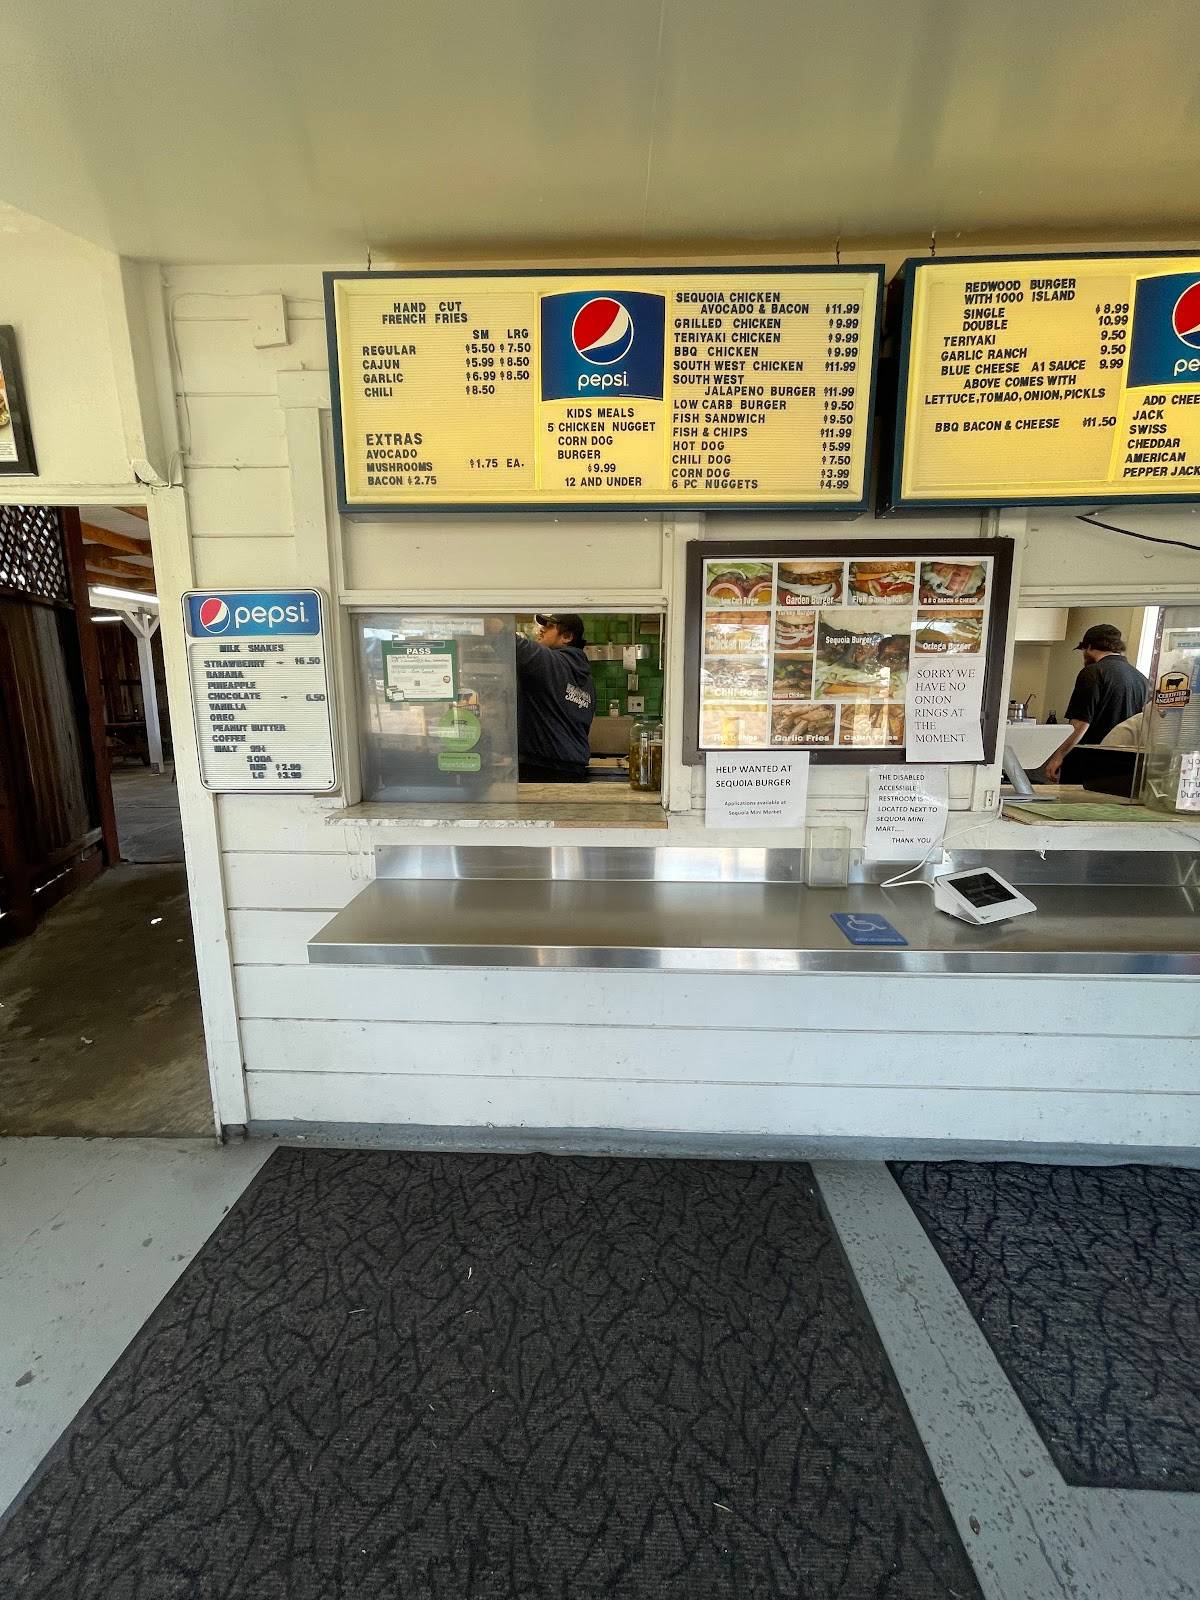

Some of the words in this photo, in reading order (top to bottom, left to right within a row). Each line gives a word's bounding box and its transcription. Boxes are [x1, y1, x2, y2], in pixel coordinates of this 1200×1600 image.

[965, 281, 1021, 292] REDWOOD
[1030, 279, 1076, 290] BURGER
[676, 293, 725, 303] SEQUOIA
[730, 293, 780, 303] CHICKEN
[965, 293, 993, 304] WITH
[996, 292, 1023, 303] 1000
[1032, 291, 1075, 302] ISLAND
[393, 302, 426, 313] HAND
[439, 302, 461, 312] CUT
[701, 304, 754, 314] AVOCADO
[759, 304, 765, 314] &
[771, 304, 809, 314] BACON
[826, 304, 859, 314] $11.99
[964, 308, 1005, 319] SINGLE
[1095, 304, 1129, 314] $8.99
[382, 314, 426, 324] FRENCH
[435, 313, 468, 323] FRIES
[674, 318, 722, 329] GRILLED
[733, 318, 781, 329] CHICKEN
[829, 318, 858, 329] $9.99
[963, 320, 1008, 331] DOUBLE
[1098, 315, 1128, 326] 10.99
[473, 330, 488, 339] SM
[507, 329, 529, 338] LRG
[362, 346, 416, 356] REGULAR
[465, 343, 495, 354] $5.50
[500, 343, 531, 353] $7.50
[941, 350, 983, 361] GARLIC
[987, 348, 1027, 359] RANCH
[1100, 345, 1126, 355] 9.50
[362, 360, 400, 369] CAJUN
[466, 358, 494, 368] $5.99
[500, 357, 529, 367] $8.50
[941, 365, 970, 376] BLUE
[975, 363, 1019, 374] CHEESE
[1031, 362, 1045, 372] A1
[1049, 360, 1086, 371] SAUCE
[1099, 359, 1123, 369] 9.99
[578, 372, 628, 390] pepsi
[673, 375, 710, 384] SOUTH
[714, 375, 744, 384] WEST
[964, 378, 1000, 389] ABOVE
[1005, 377, 1043, 388] COMES
[1047, 375, 1076, 386] WITH
[365, 387, 393, 397] CHILI
[465, 385, 495, 395] $8.50
[704, 386, 764, 397] JALAPENO
[771, 386, 815, 396] BURGER
[824, 386, 854, 397] $11.99
[674, 400, 698, 409] LOW
[701, 400, 732, 410] CARB
[740, 400, 786, 410] BURGER
[824, 401, 854, 411] $9.50
[1143, 395, 1166, 405] ADD
[567, 408, 592, 418] KIDS
[598, 408, 634, 418] MEALS
[1133, 410, 1164, 420] JACK
[548, 423, 554, 432] 5
[558, 422, 605, 432] CHICKEN
[612, 422, 655, 431] NUGGET
[935, 421, 959, 432] BBQ
[963, 420, 1000, 431] BACON
[1005, 420, 1011, 431] &
[1016, 418, 1060, 430] CHEESE
[1083, 417, 1116, 428] $11.50
[1129, 424, 1167, 435] SWISS
[366, 433, 423, 445] EXTRAS
[558, 436, 588, 445] CORN
[591, 436, 613, 445] DOG
[1128, 438, 1180, 449] CHEDDAR
[674, 441, 695, 451] HOT
[701, 441, 724, 451] DOG
[822, 442, 850, 452] $5.99
[366, 449, 417, 459] AVOCADO
[558, 449, 601, 459] BURGER
[1125, 452, 1186, 463] AMERICAN
[367, 462, 433, 472] MUSHROOMS
[470, 459, 498, 469] $1.75
[507, 459, 524, 468] EA.
[588, 464, 616, 473] $9.99
[1123, 467, 1168, 477] PEPPER
[1171, 466, 1200, 476] JACK
[672, 480, 678, 489] 6
[684, 480, 698, 489] PC
[705, 479, 758, 489] NUGGETS
[820, 480, 849, 490] $4.99
[786, 596, 809, 605] Garden
[811, 596, 834, 606] Burger
[235, 602, 305, 628] pepsi
[852, 637, 872, 645] Burger
[248, 644, 284, 652] SHAKES
[917, 670, 954, 678] SORRY
[957, 669, 975, 678] WE
[916, 683, 946, 691] HAVE
[949, 683, 966, 691] NO
[915, 696, 951, 704] ONION
[915, 709, 948, 717] RINGS
